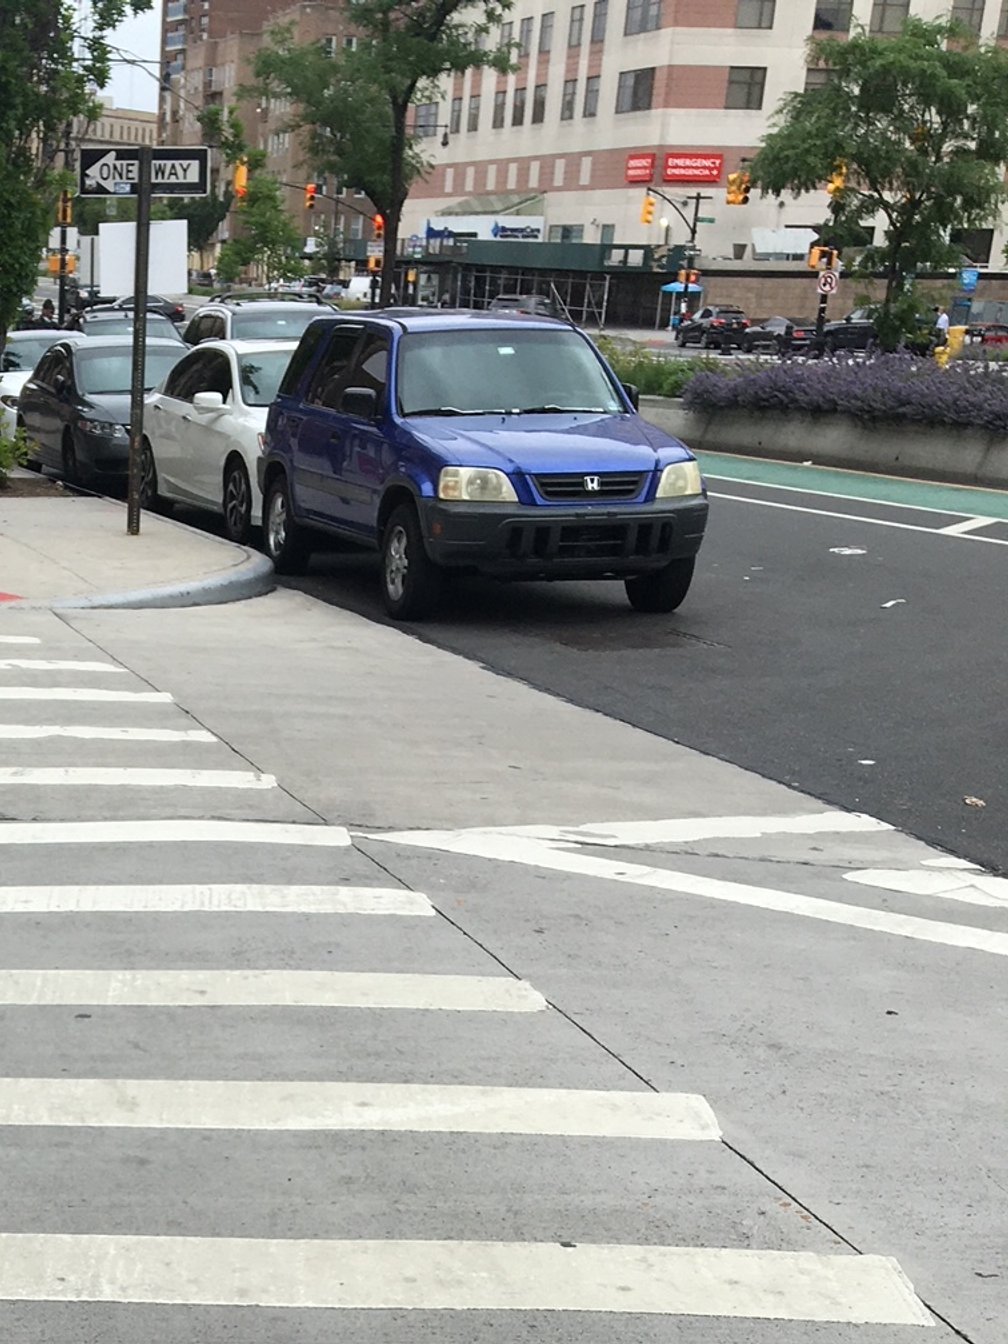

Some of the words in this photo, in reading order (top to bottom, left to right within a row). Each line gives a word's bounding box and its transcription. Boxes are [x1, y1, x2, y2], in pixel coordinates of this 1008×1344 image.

[668, 157, 722, 168] EMERGENCY
[99, 162, 136, 181] ONE
[153, 162, 192, 181] WAY
